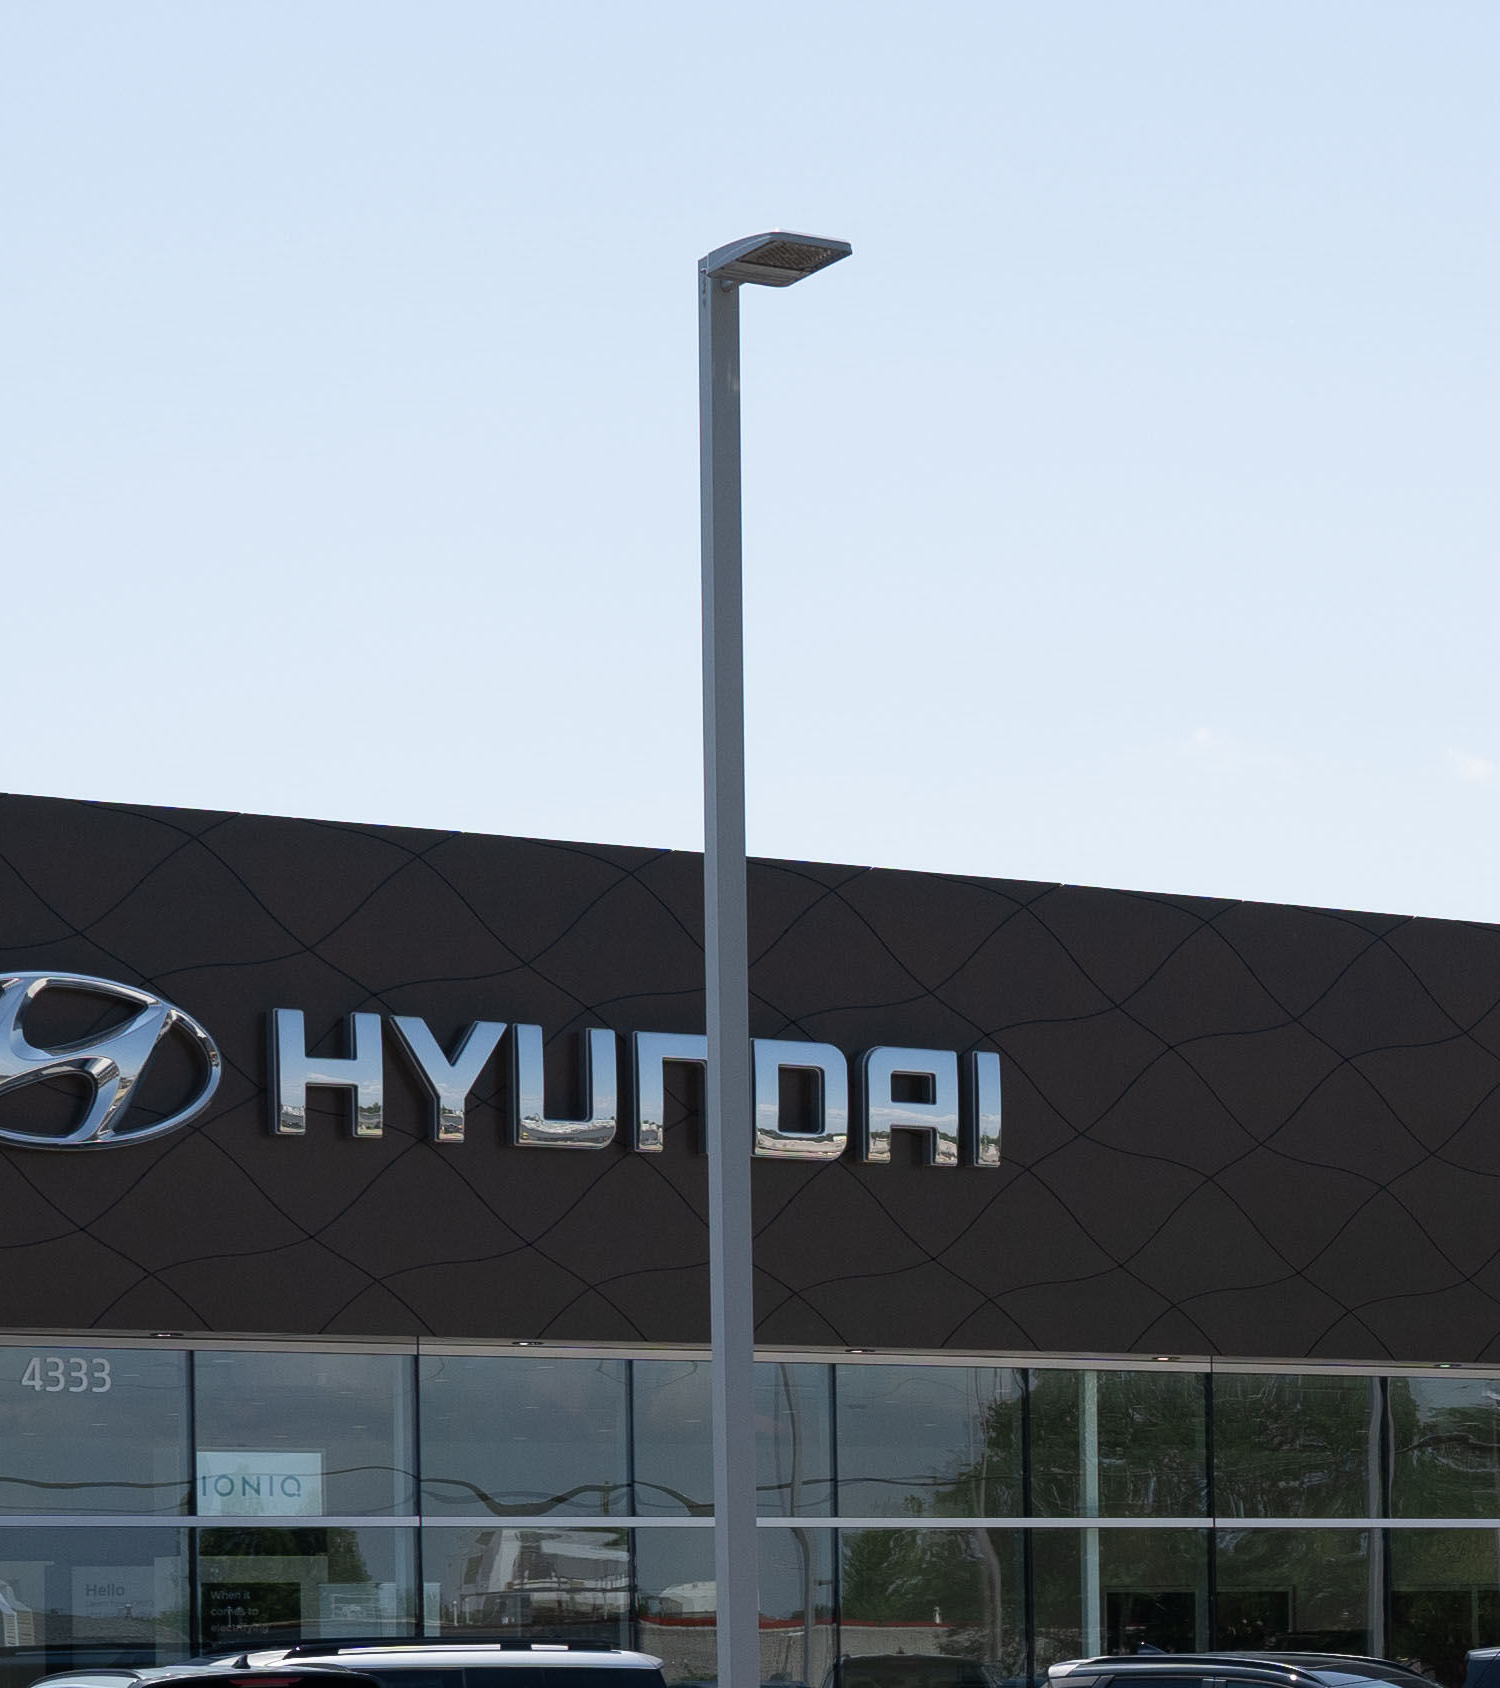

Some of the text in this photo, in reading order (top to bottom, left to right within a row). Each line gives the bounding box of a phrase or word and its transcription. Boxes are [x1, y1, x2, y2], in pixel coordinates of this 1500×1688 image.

[267, 1006, 1002, 1168] HYUNDAI
[21, 1356, 112, 1393] 4333
[201, 1474, 302, 1498] IONIQ
[85, 1583, 125, 1598] Hello
[210, 1590, 241, 1600] When
